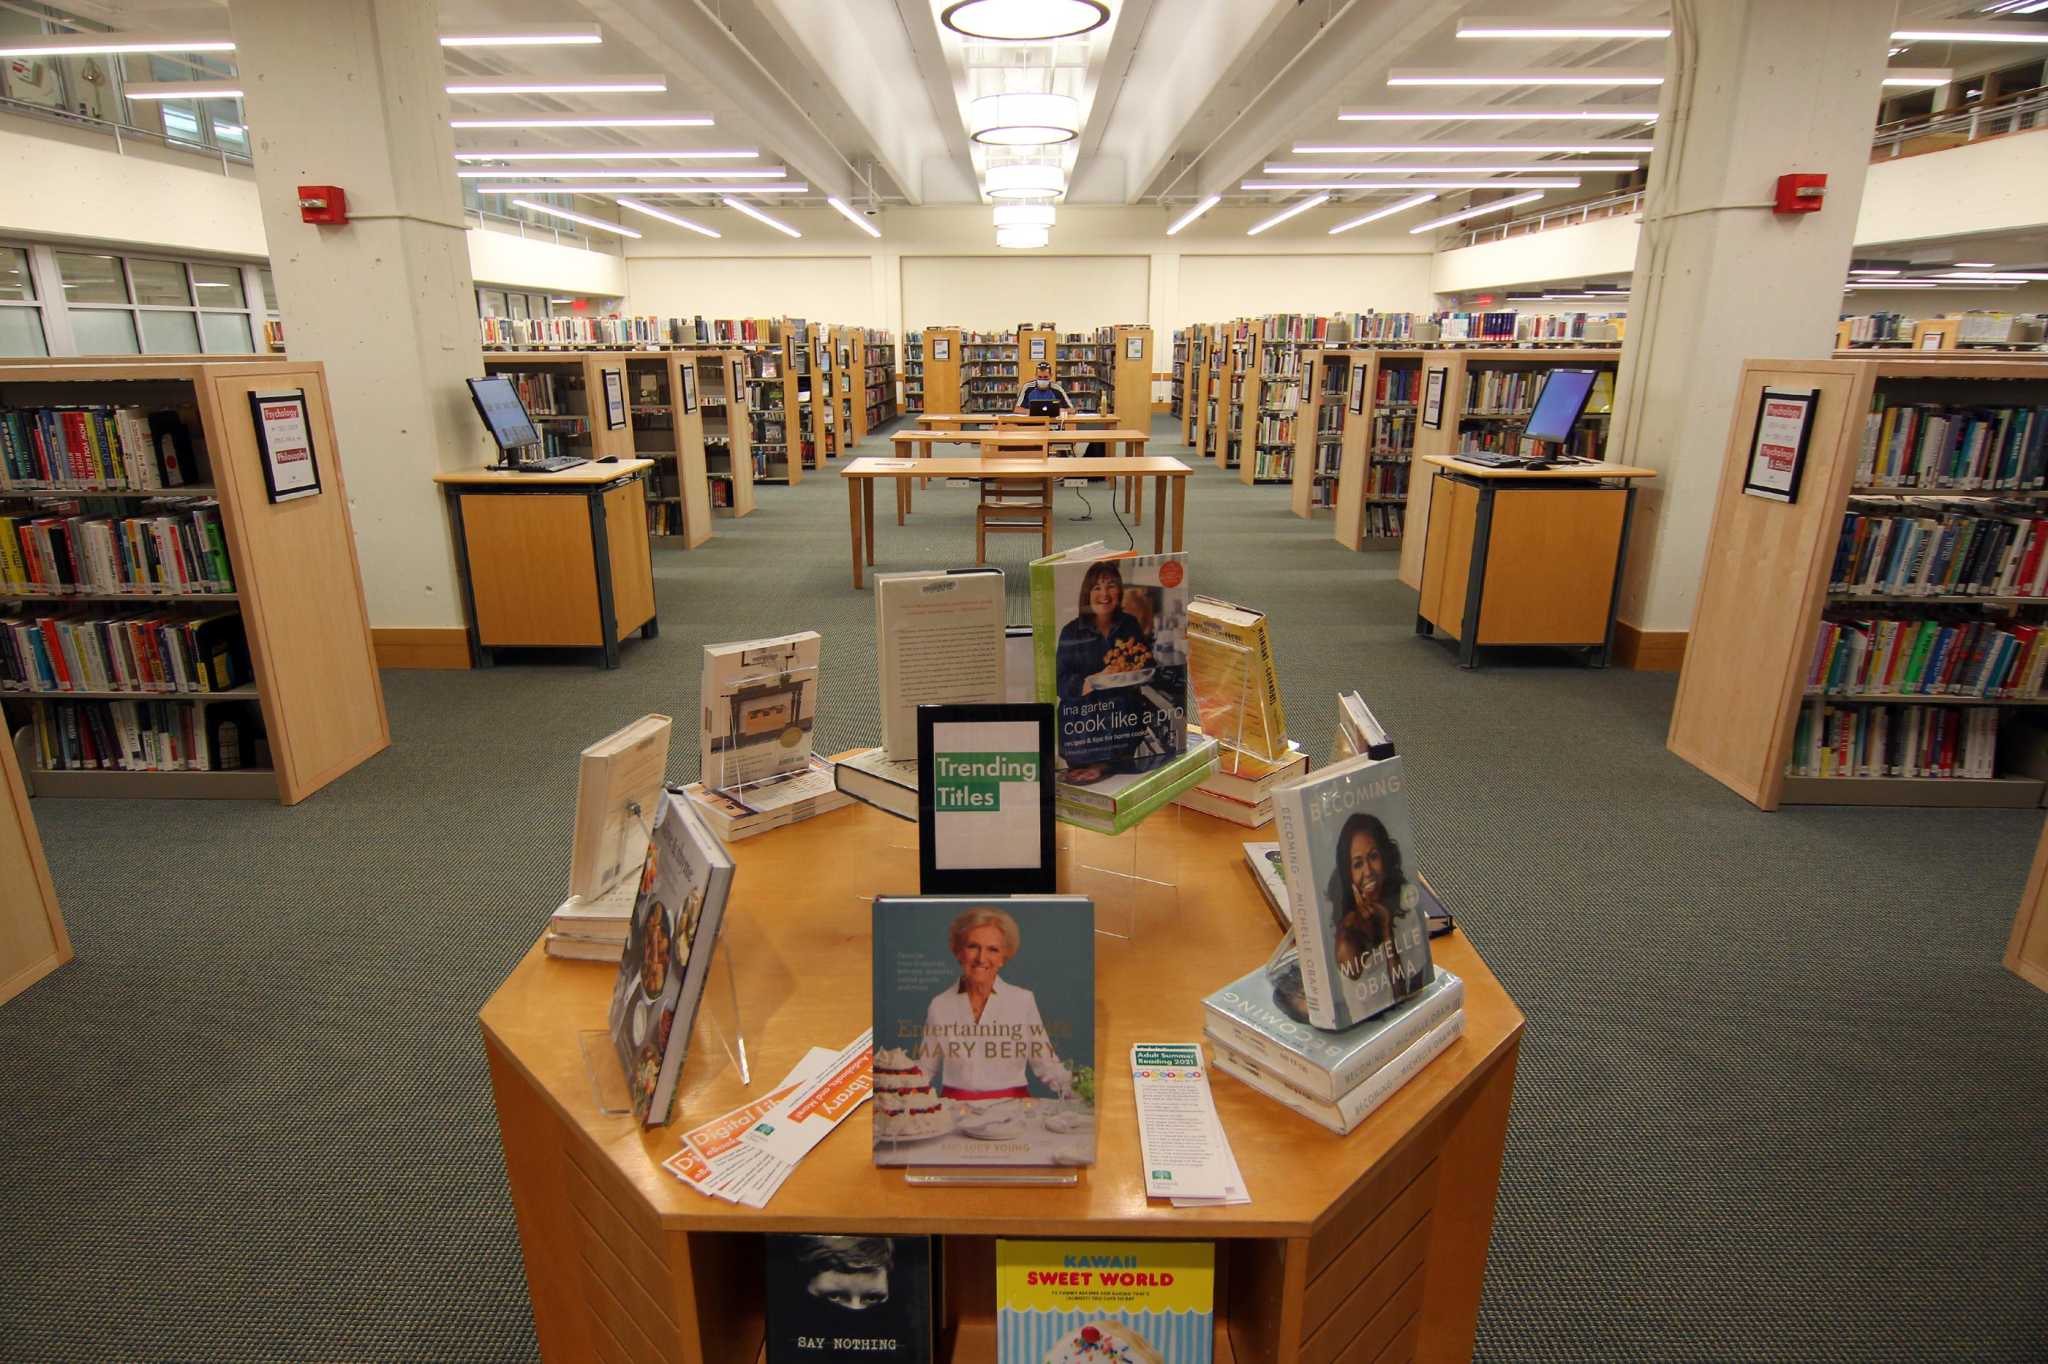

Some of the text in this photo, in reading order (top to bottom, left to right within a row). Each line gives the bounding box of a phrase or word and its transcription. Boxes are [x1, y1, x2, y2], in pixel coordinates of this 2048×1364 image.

[1063, 701, 1115, 716] ina garten
[1064, 706, 1184, 735] cook like a pro
[937, 756, 1037, 781] Trending
[937, 785, 994, 806] Titles
[1310, 775, 1401, 822] BECOMING
[1281, 807, 1300, 874] BECOMING
[1296, 892, 1313, 951] MICHELLE
[1338, 930, 1421, 978] MICHELLE
[1354, 960, 1418, 1003] OBAMA
[896, 1018, 1023, 1041] Entertaining
[1222, 991, 1345, 1058] BECOMING
[911, 1042, 1057, 1059] MARY BERRY
[1138, 1058, 1173, 1066] Reading
[823, 1073, 873, 1115] Library
[693, 1105, 756, 1146] Digital
[993, 1143, 1031, 1153] YOUNG
[1064, 1255, 1137, 1268] KAWAII
[1027, 1271, 1174, 1286] SWEET WORLD
[797, 1336, 897, 1351] SAY NOTHING
